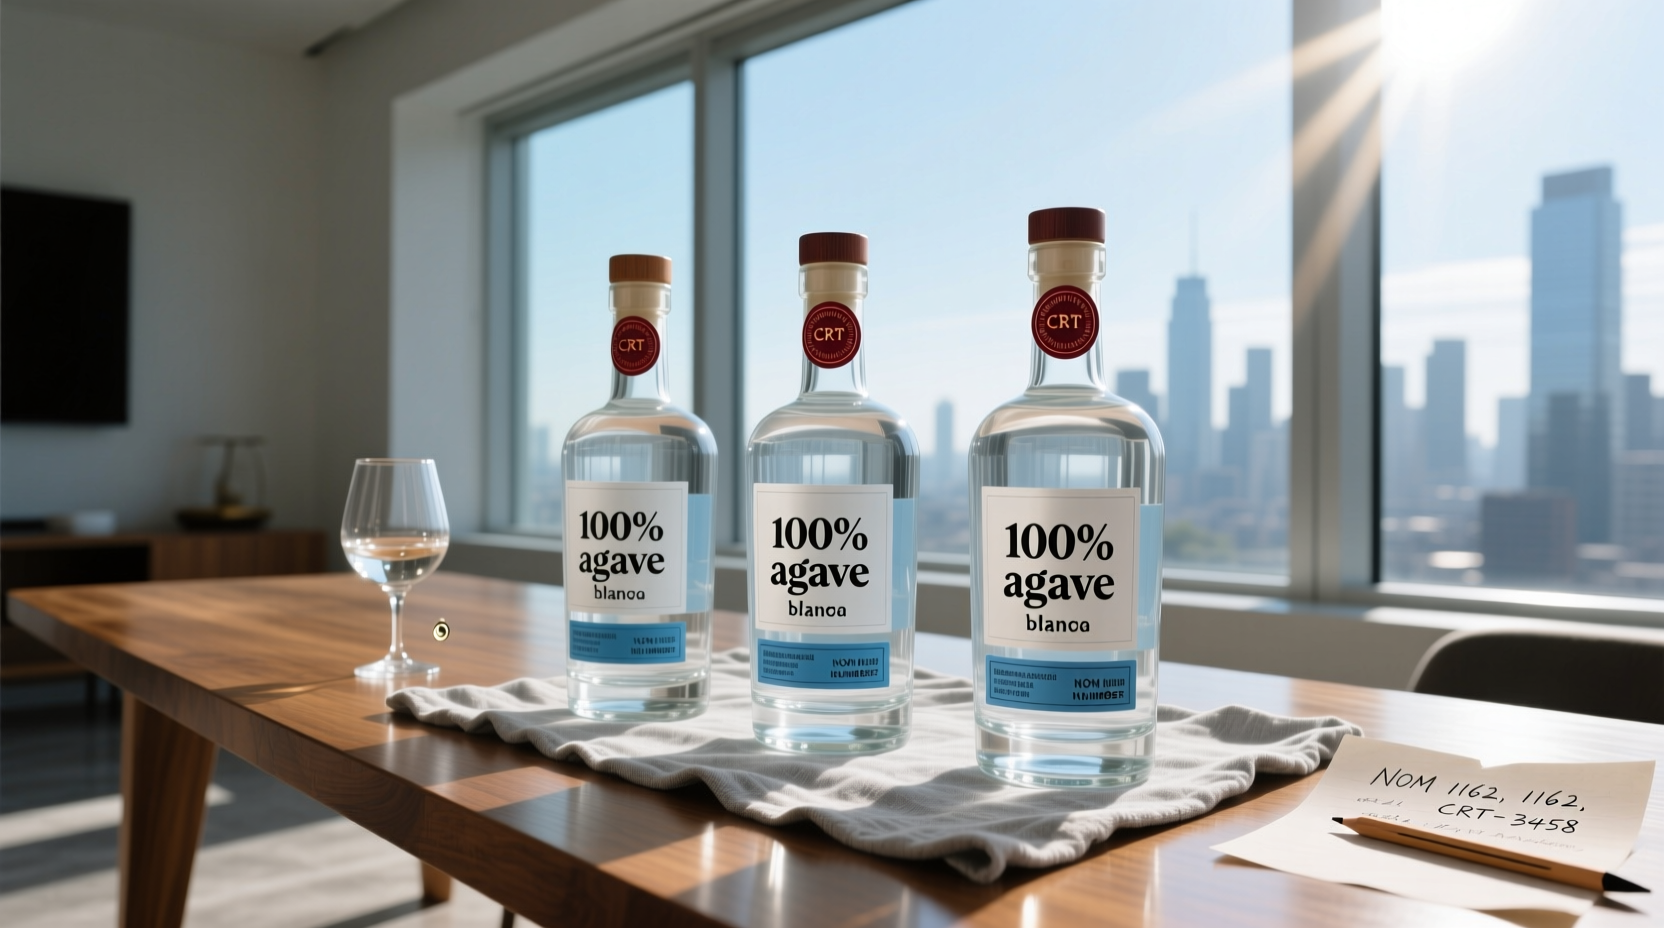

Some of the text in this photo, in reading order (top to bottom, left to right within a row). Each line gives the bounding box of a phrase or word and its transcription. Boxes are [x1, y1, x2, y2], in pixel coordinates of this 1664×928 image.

[813, 327, 845, 341] CRT
[1046, 314, 1082, 329] CRT
[618, 338, 645, 352] CRT
[579, 510, 664, 542] 100%
[772, 517, 868, 551] 100%
[1005, 522, 1114, 562] 100%
[578, 549, 665, 583] agave
[770, 558, 869, 596] agave
[1003, 569, 1115, 610] agave
[1369, 766, 1586, 813] NOM 1162, 1162,
